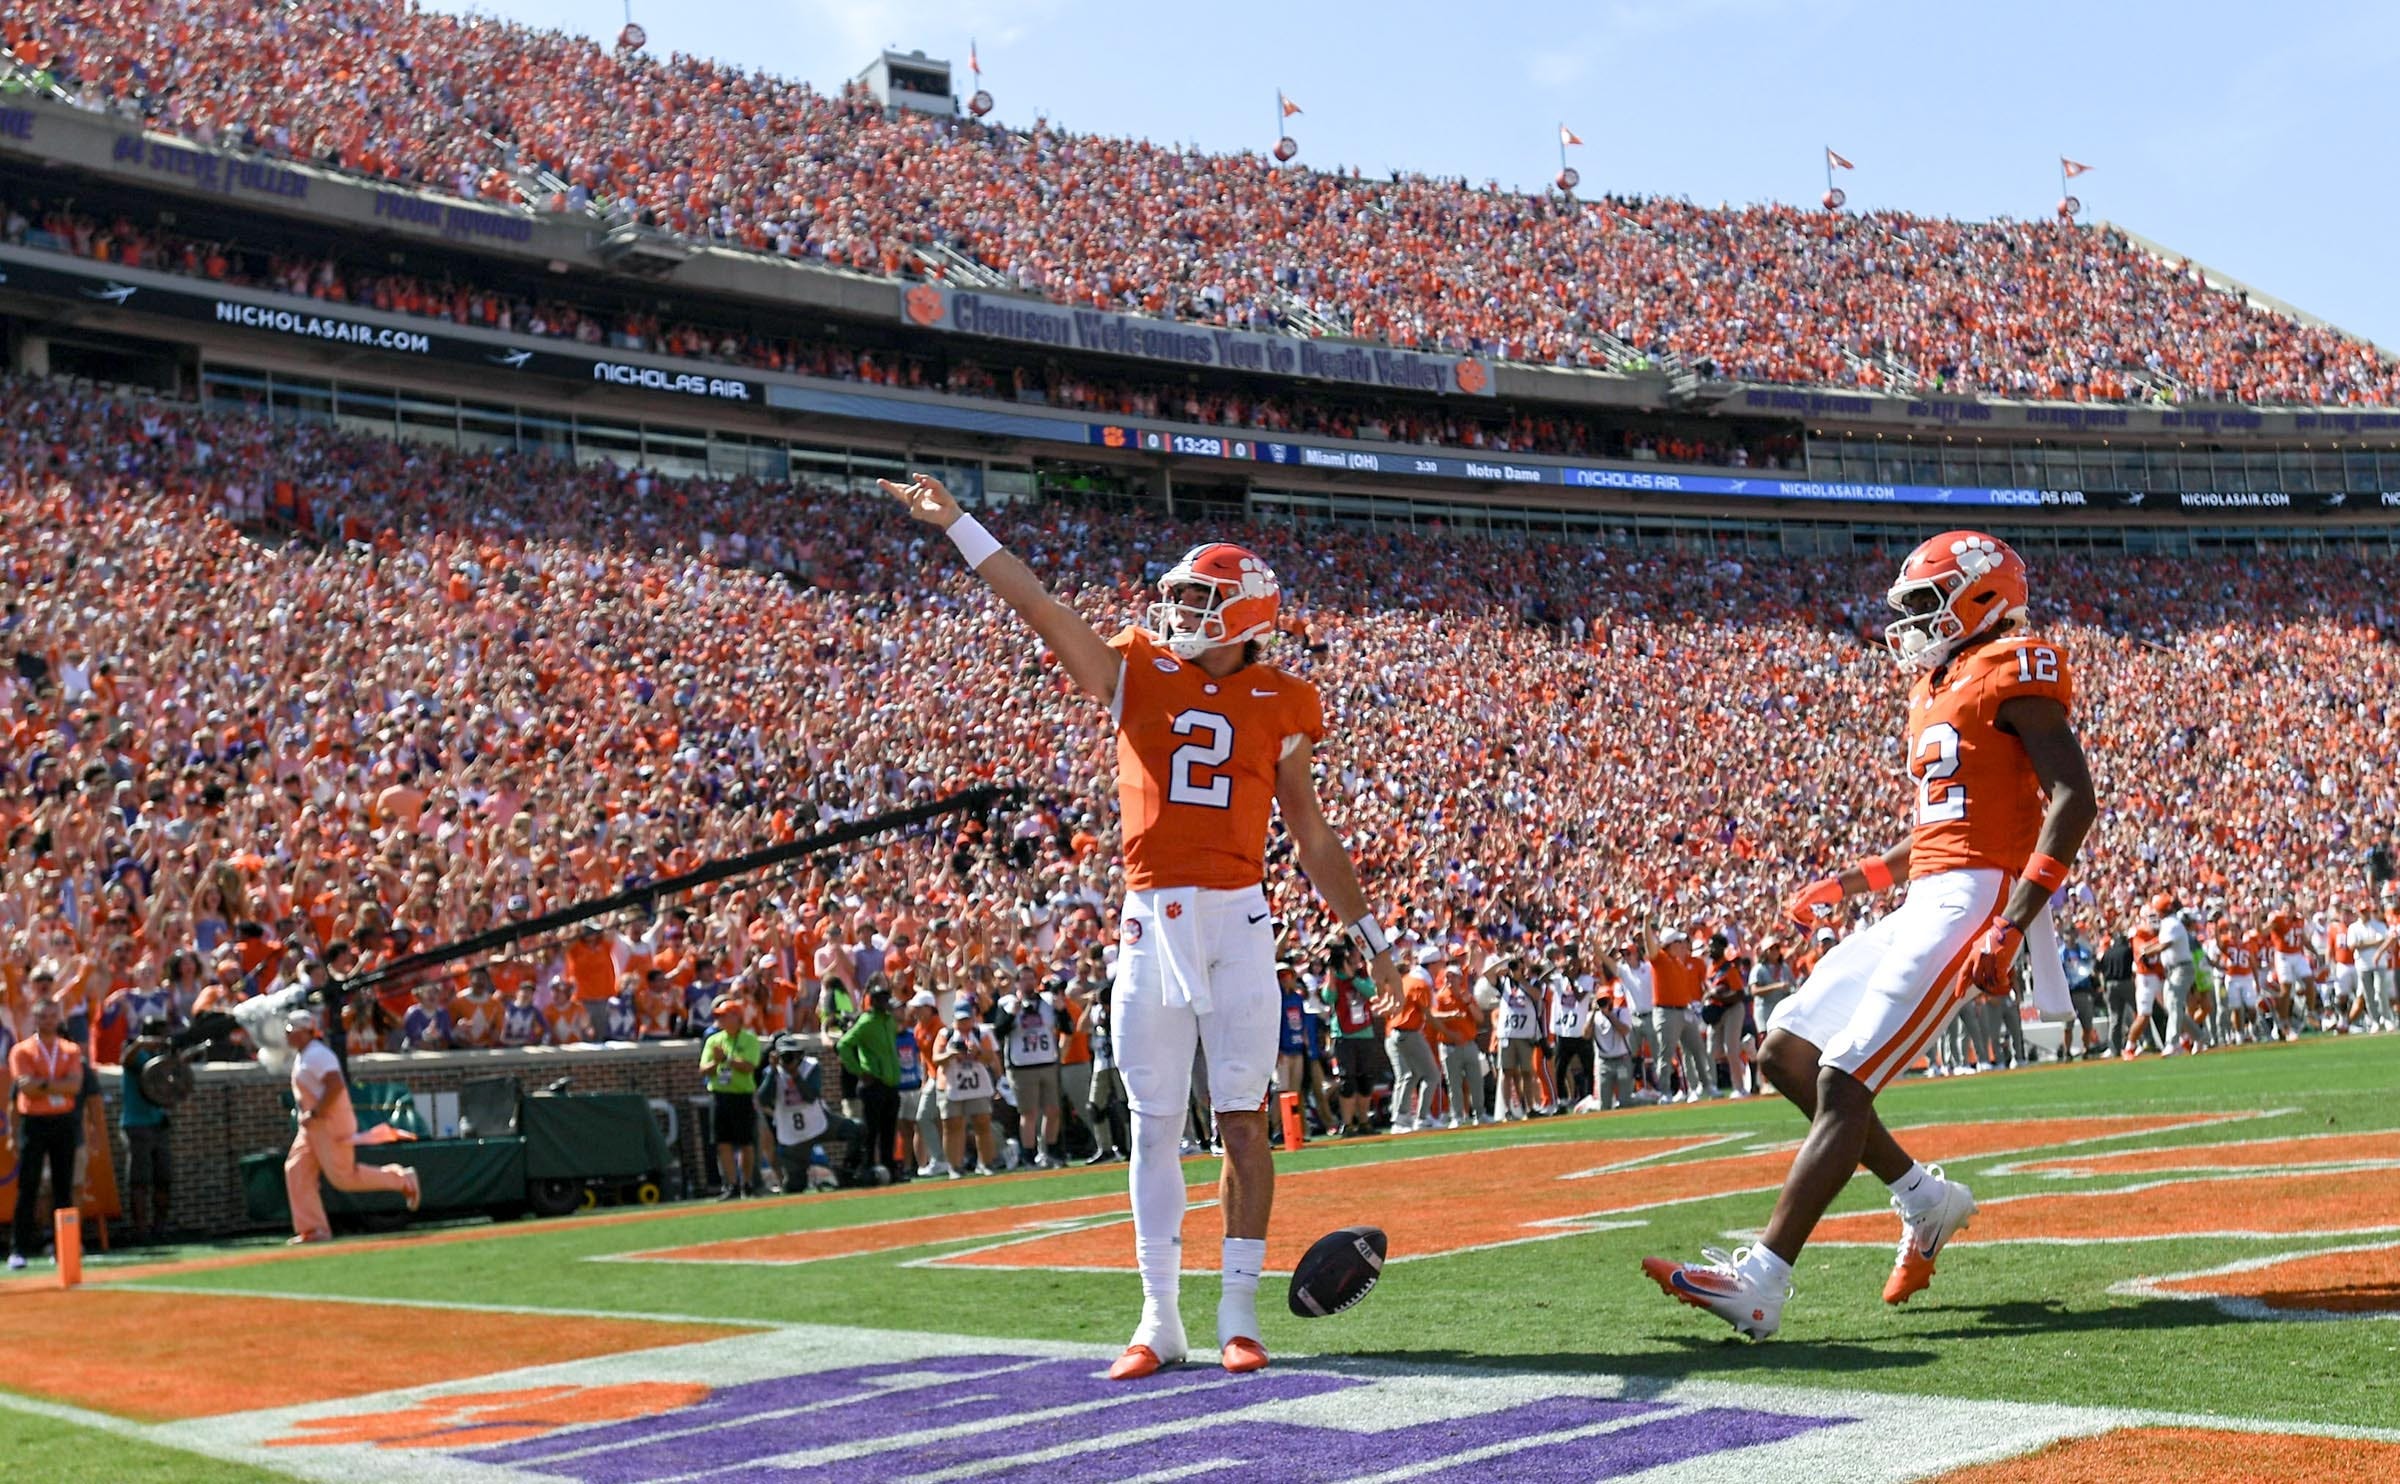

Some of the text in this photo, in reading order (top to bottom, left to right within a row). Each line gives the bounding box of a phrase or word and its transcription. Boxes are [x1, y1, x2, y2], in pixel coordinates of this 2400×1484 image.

[216, 301, 429, 353] NICHOLASAIR.COM
[951, 292, 1449, 395] Clemson Welcomes You to Death Valley
[593, 361, 707, 395] NICHOLAS
[1147, 433, 1246, 457] 0 13:29 0
[1305, 449, 1379, 472] Miami (OH)
[1415, 460, 1438, 473] 3:30
[1466, 463, 1541, 482] Notre Dame
[1577, 470, 1653, 488] NICHOLAS
[1780, 482, 1896, 500] NICHOLASAIR.COM
[1990, 488, 2060, 505] NICHOLAS
[2180, 492, 2291, 507] NICHOLASAIR.COM
[2015, 647, 2060, 683] 12
[1169, 708, 1234, 809] 2
[957, 1072, 979, 1091] 20
[793, 1112, 805, 1131] 8
